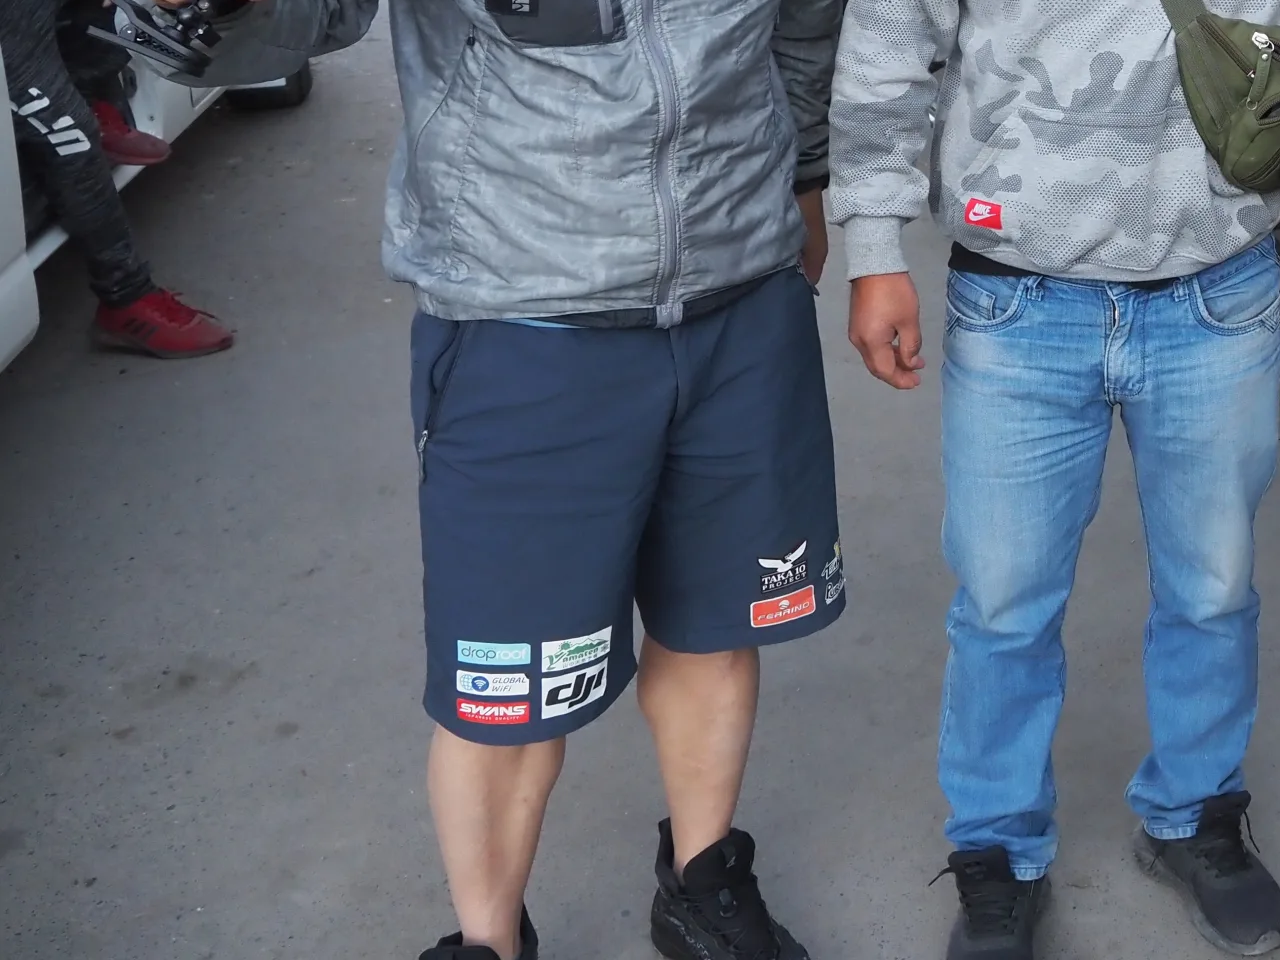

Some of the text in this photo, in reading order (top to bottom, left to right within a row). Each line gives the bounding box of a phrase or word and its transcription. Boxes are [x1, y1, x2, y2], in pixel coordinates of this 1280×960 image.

[761, 569, 793, 585] TAKA
[794, 563, 806, 575] 10
[762, 572, 806, 591] PROJECT
[757, 601, 810, 621] FERRINO
[461, 645, 528, 662] droproof
[459, 702, 528, 716] SWANS
